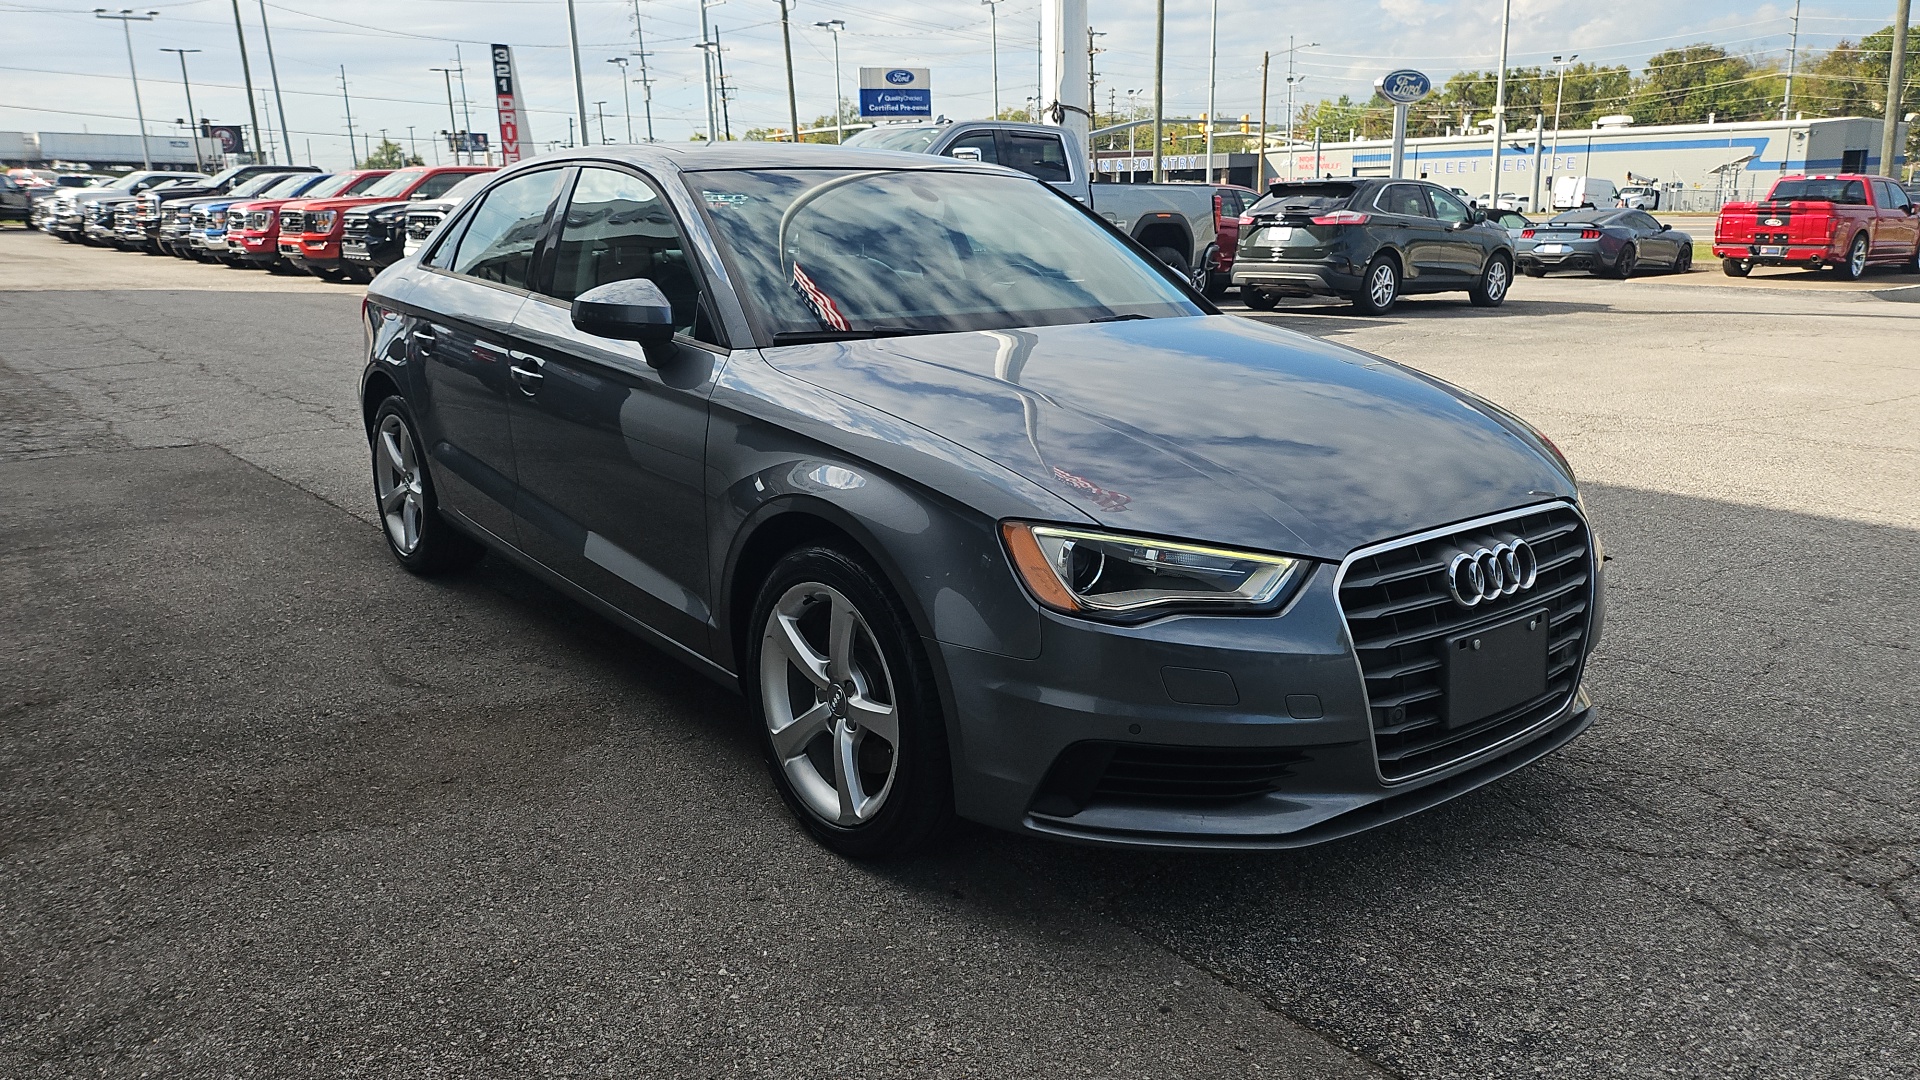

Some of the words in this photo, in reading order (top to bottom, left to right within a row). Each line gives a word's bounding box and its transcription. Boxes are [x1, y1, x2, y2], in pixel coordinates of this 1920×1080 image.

[494, 48, 511, 92] 321
[892, 72, 911, 82] Ford
[1392, 75, 1423, 96] Ford
[1116, 160, 1124, 172] &
[1298, 162, 1341, 171] NASVILLE
[1422, 160, 1480, 174] FLEET
